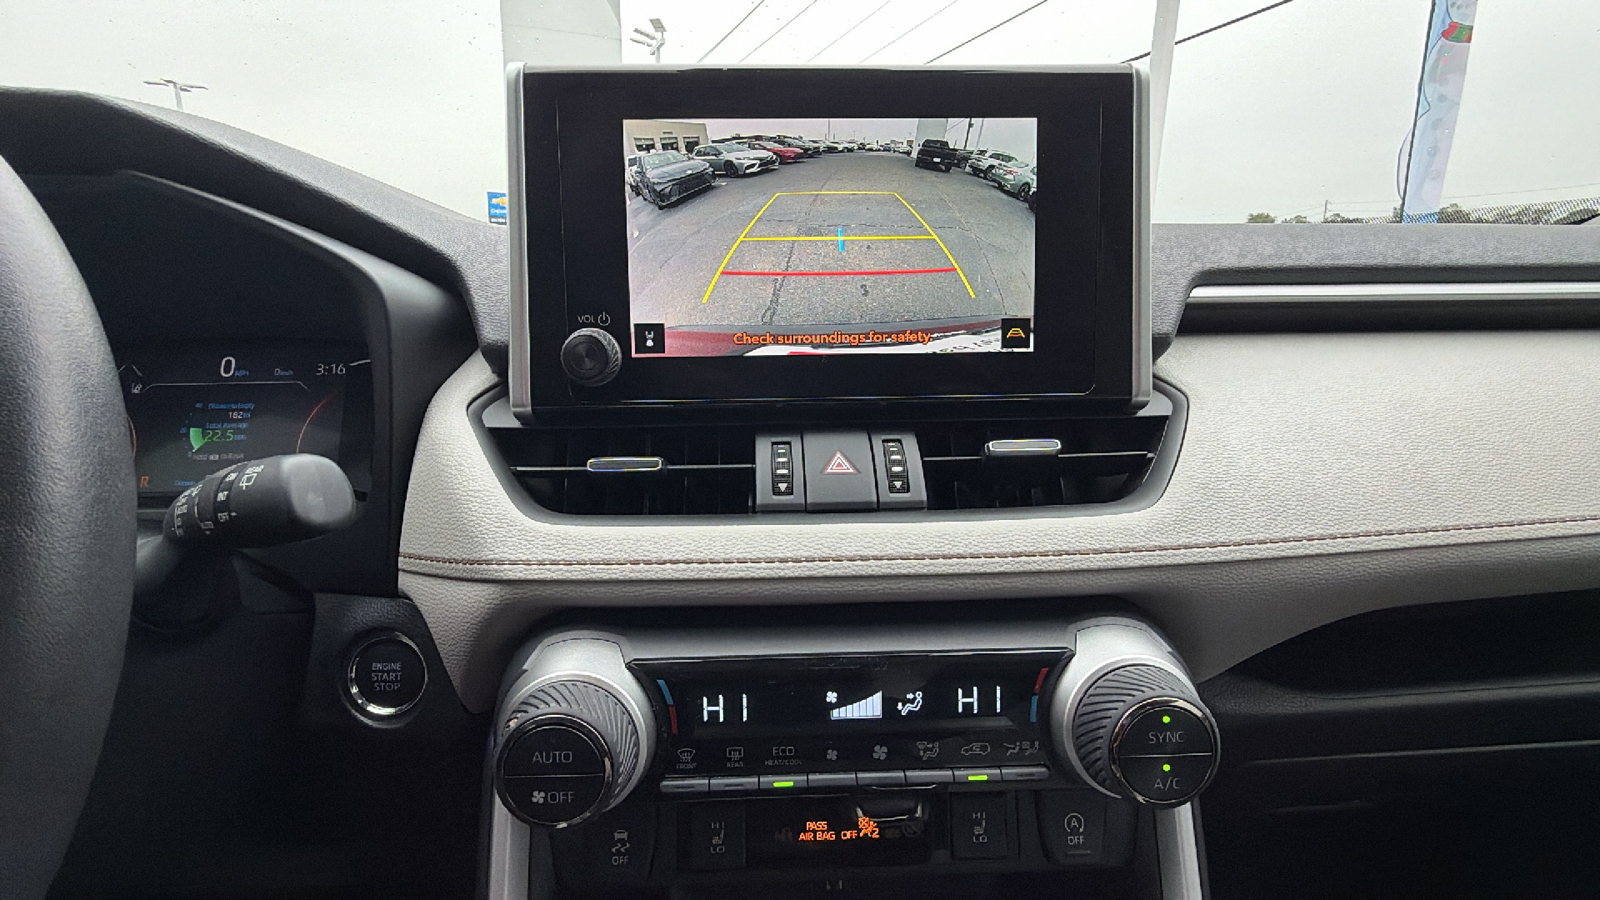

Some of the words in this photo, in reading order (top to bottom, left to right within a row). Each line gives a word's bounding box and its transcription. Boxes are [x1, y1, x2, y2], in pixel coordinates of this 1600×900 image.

[577, 314, 596, 324] VOL
[733, 332, 774, 345] Check
[777, 331, 866, 346] surroundings
[868, 331, 888, 342] for
[890, 330, 934, 345] safety.
[220, 356, 236, 378] 0
[316, 363, 346, 376] 3:16
[204, 429, 234, 442] 22.5
[140, 475, 150, 488] R
[371, 662, 402, 671] ENGINE
[371, 672, 402, 681] START
[374, 682, 401, 691] STOP
[1148, 731, 1185, 744] SYNC
[772, 746, 795, 756] ECO
[532, 751, 573, 764] AUTO
[1153, 777, 1181, 790] A/C
[547, 791, 576, 804] OFF
[806, 821, 828, 831] PASS
[799, 832, 814, 841] AIR
[816, 831, 836, 841] BAG
[840, 830, 858, 840] OFF
[1067, 836, 1085, 846] OFF
[611, 856, 629, 865] OFF
